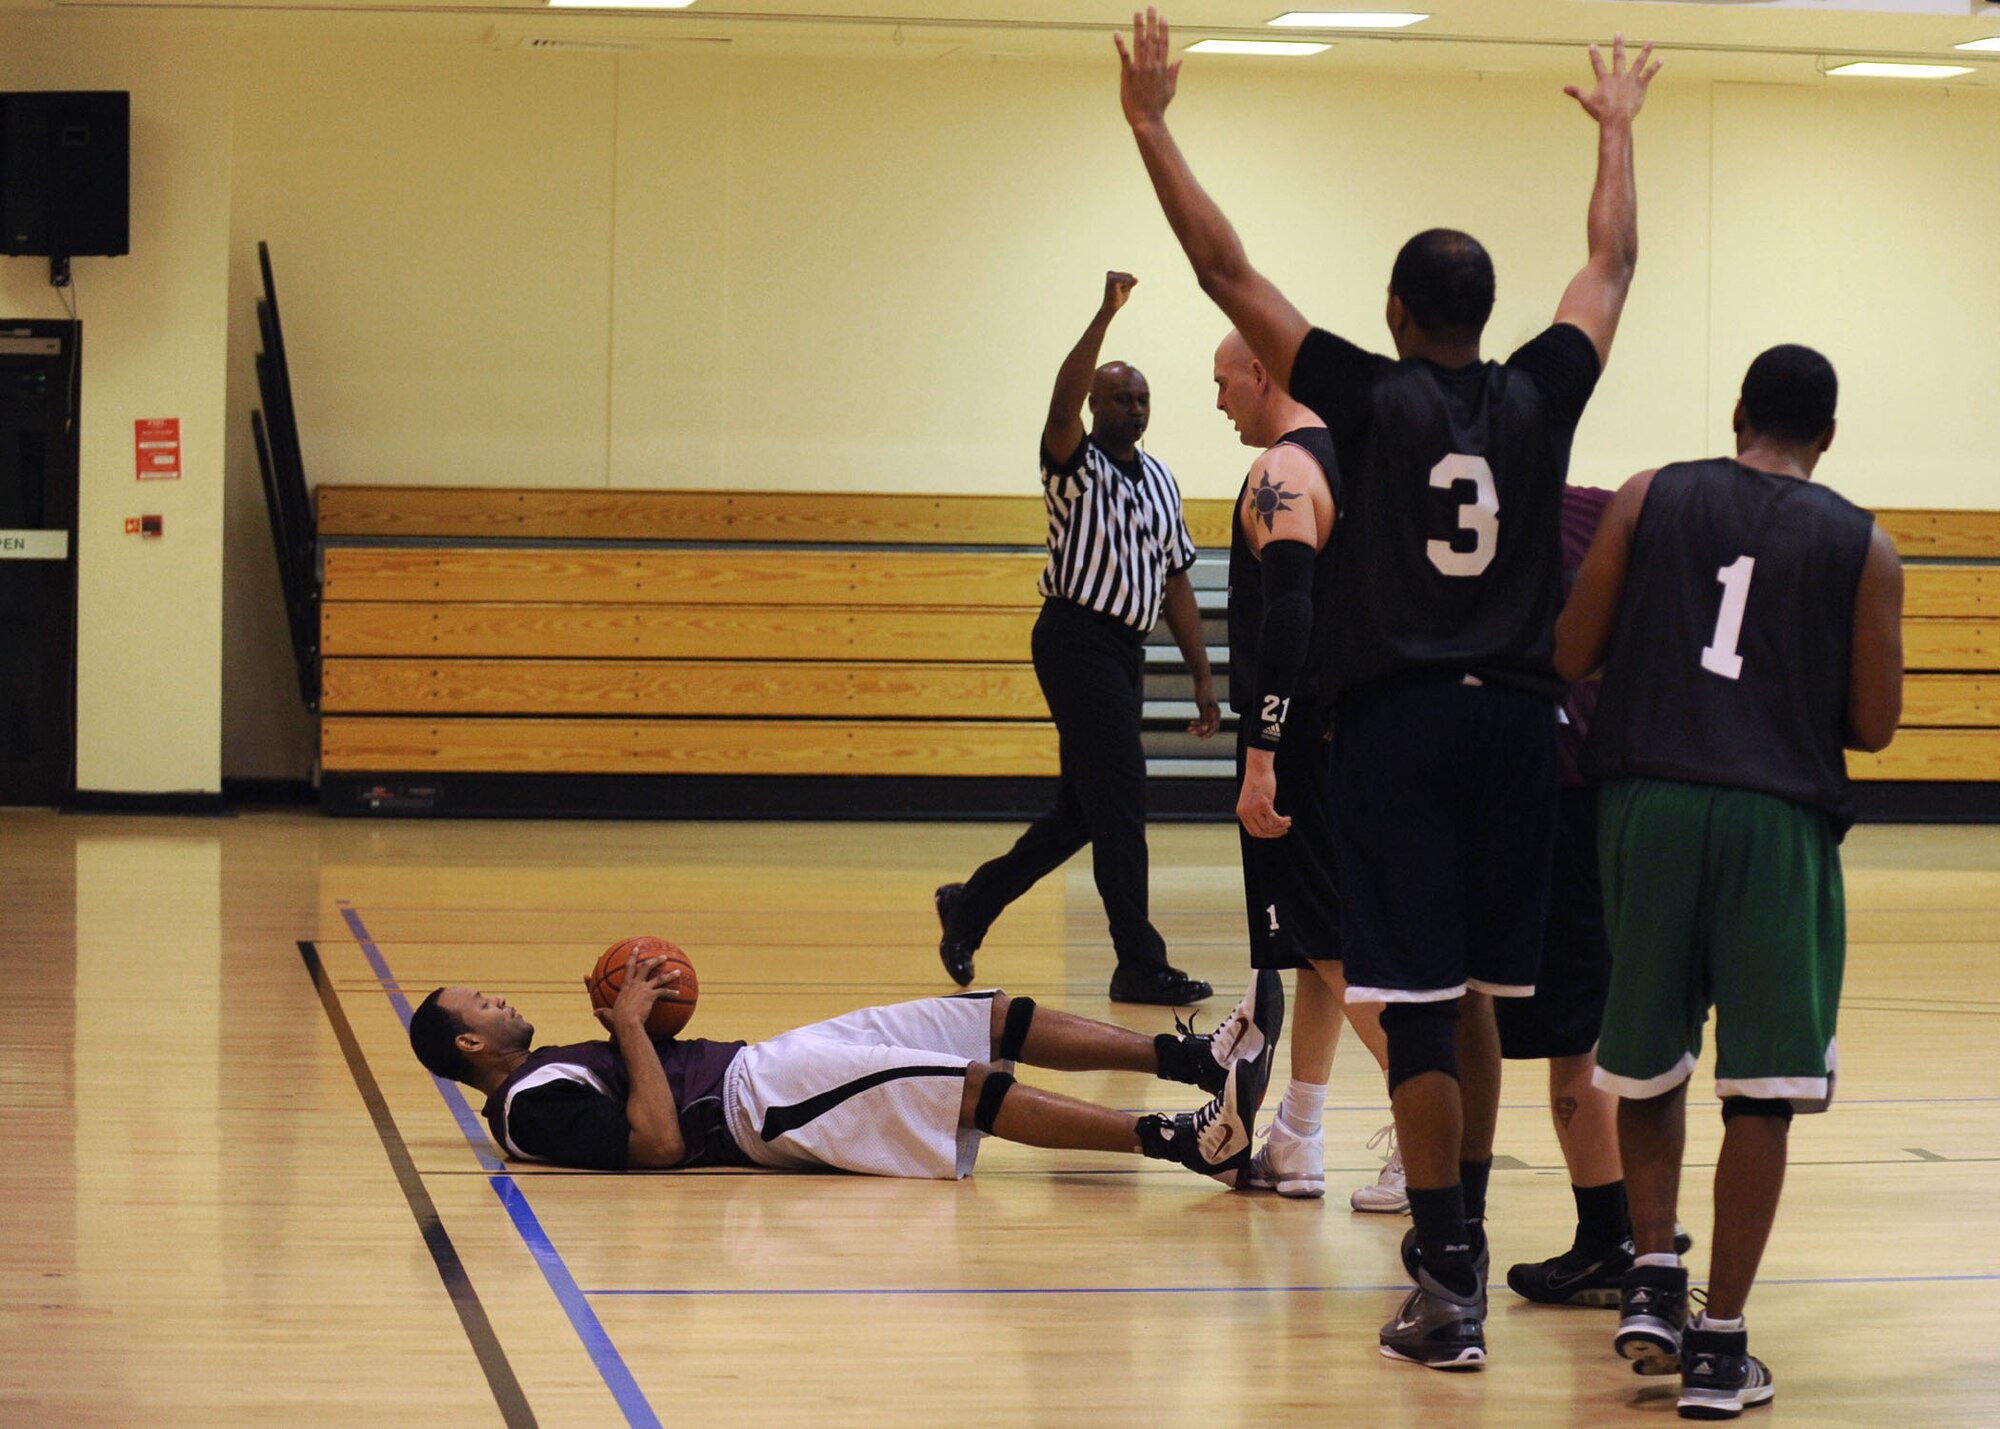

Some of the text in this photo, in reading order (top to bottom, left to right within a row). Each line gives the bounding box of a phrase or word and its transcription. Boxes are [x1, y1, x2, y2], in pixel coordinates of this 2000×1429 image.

[1427, 453, 1499, 577] 3
[0, 537, 25, 550] EN
[1701, 555, 1756, 680] 1
[1261, 694, 1290, 723] 21
[1266, 904, 1280, 930] 1
